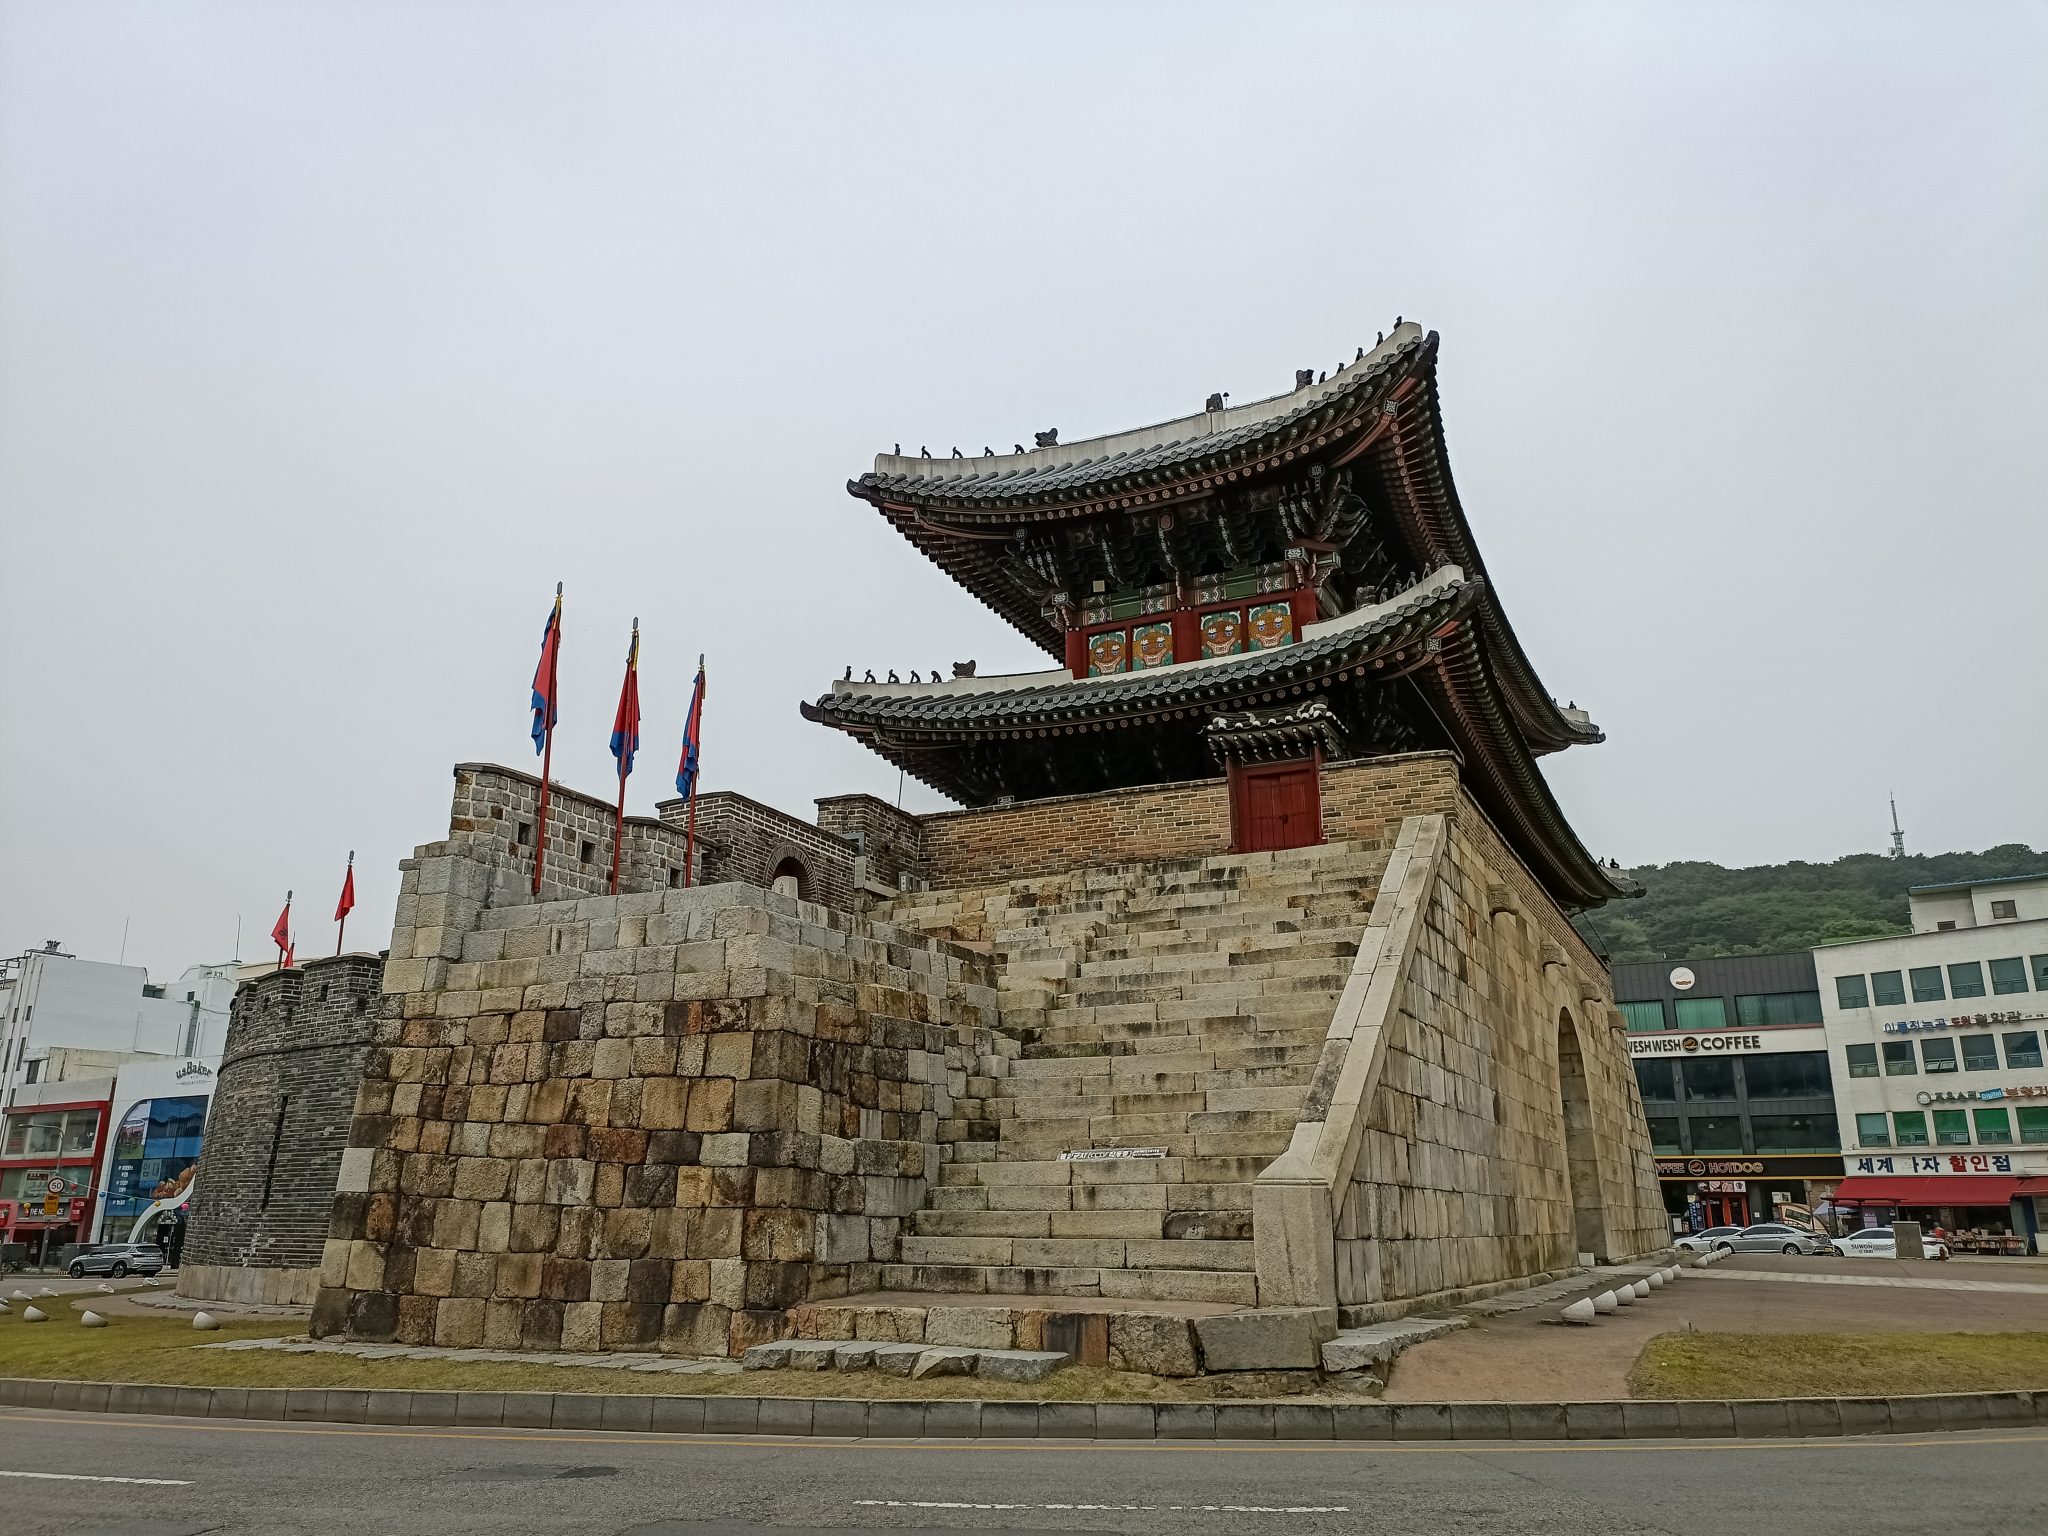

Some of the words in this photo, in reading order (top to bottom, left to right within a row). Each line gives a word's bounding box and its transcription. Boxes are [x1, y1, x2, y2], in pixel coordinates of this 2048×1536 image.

[1651, 1039, 1682, 1052] WESH
[1700, 1035, 1761, 1050] COFFEE
[1981, 1089, 2003, 1099] Digital
[1708, 1161, 1764, 1174] HOTDOG
[1858, 1156, 1894, 1173] 세계
[1949, 1154, 2012, 1172] 할인점
[51, 1181, 62, 1190] 50
